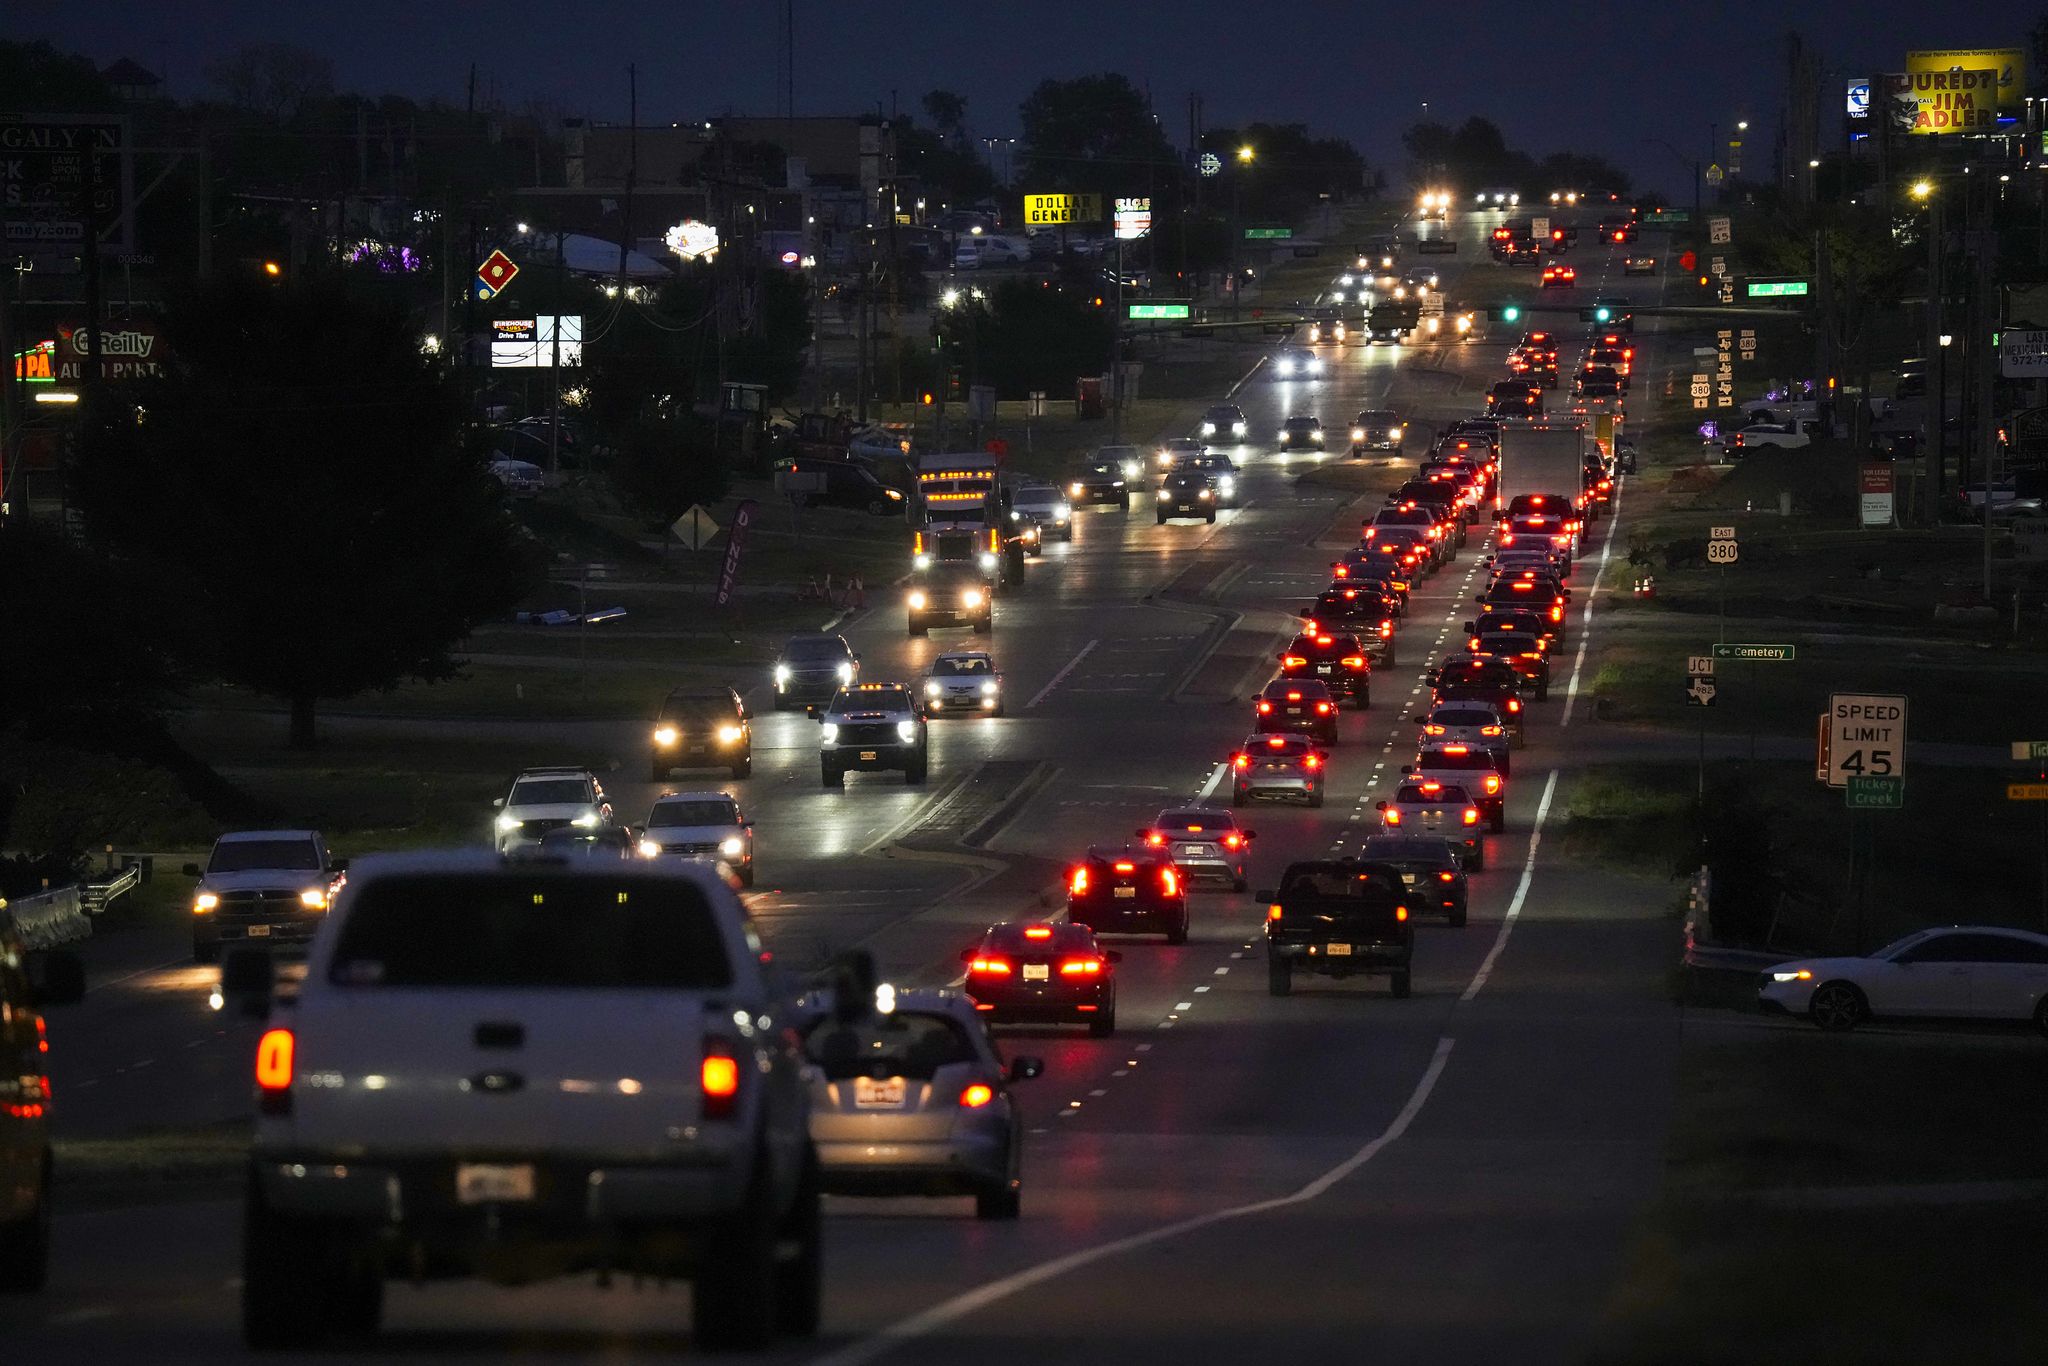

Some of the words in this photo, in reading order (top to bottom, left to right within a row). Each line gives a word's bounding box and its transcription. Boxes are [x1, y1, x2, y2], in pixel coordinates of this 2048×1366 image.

[1932, 93, 1974, 110] JIM
[1915, 109, 1991, 128] ADLER
[2, 128, 118, 148] GALYN
[1036, 197, 1090, 209] DOLLAR
[1713, 233, 1729, 241] 45
[494, 320, 534, 328] FIREHOUSE
[1740, 339, 1757, 348] 380
[2026, 332, 2044, 343] LAS
[2004, 344, 2042, 356] MEXICAN
[1692, 386, 1709, 395] 380
[1714, 528, 1732, 537] EAST
[1710, 545, 1736, 558] 380
[1734, 647, 1786, 659] Cemetery
[1690, 659, 1713, 672] JCT
[1696, 686, 1713, 695] 982
[1836, 704, 1900, 720] SPEED
[1843, 727, 1892, 742] LIMIT
[1840, 750, 1892, 775] 45
[1855, 778, 1896, 791] Tickey
[1855, 793, 1893, 805] Creek
